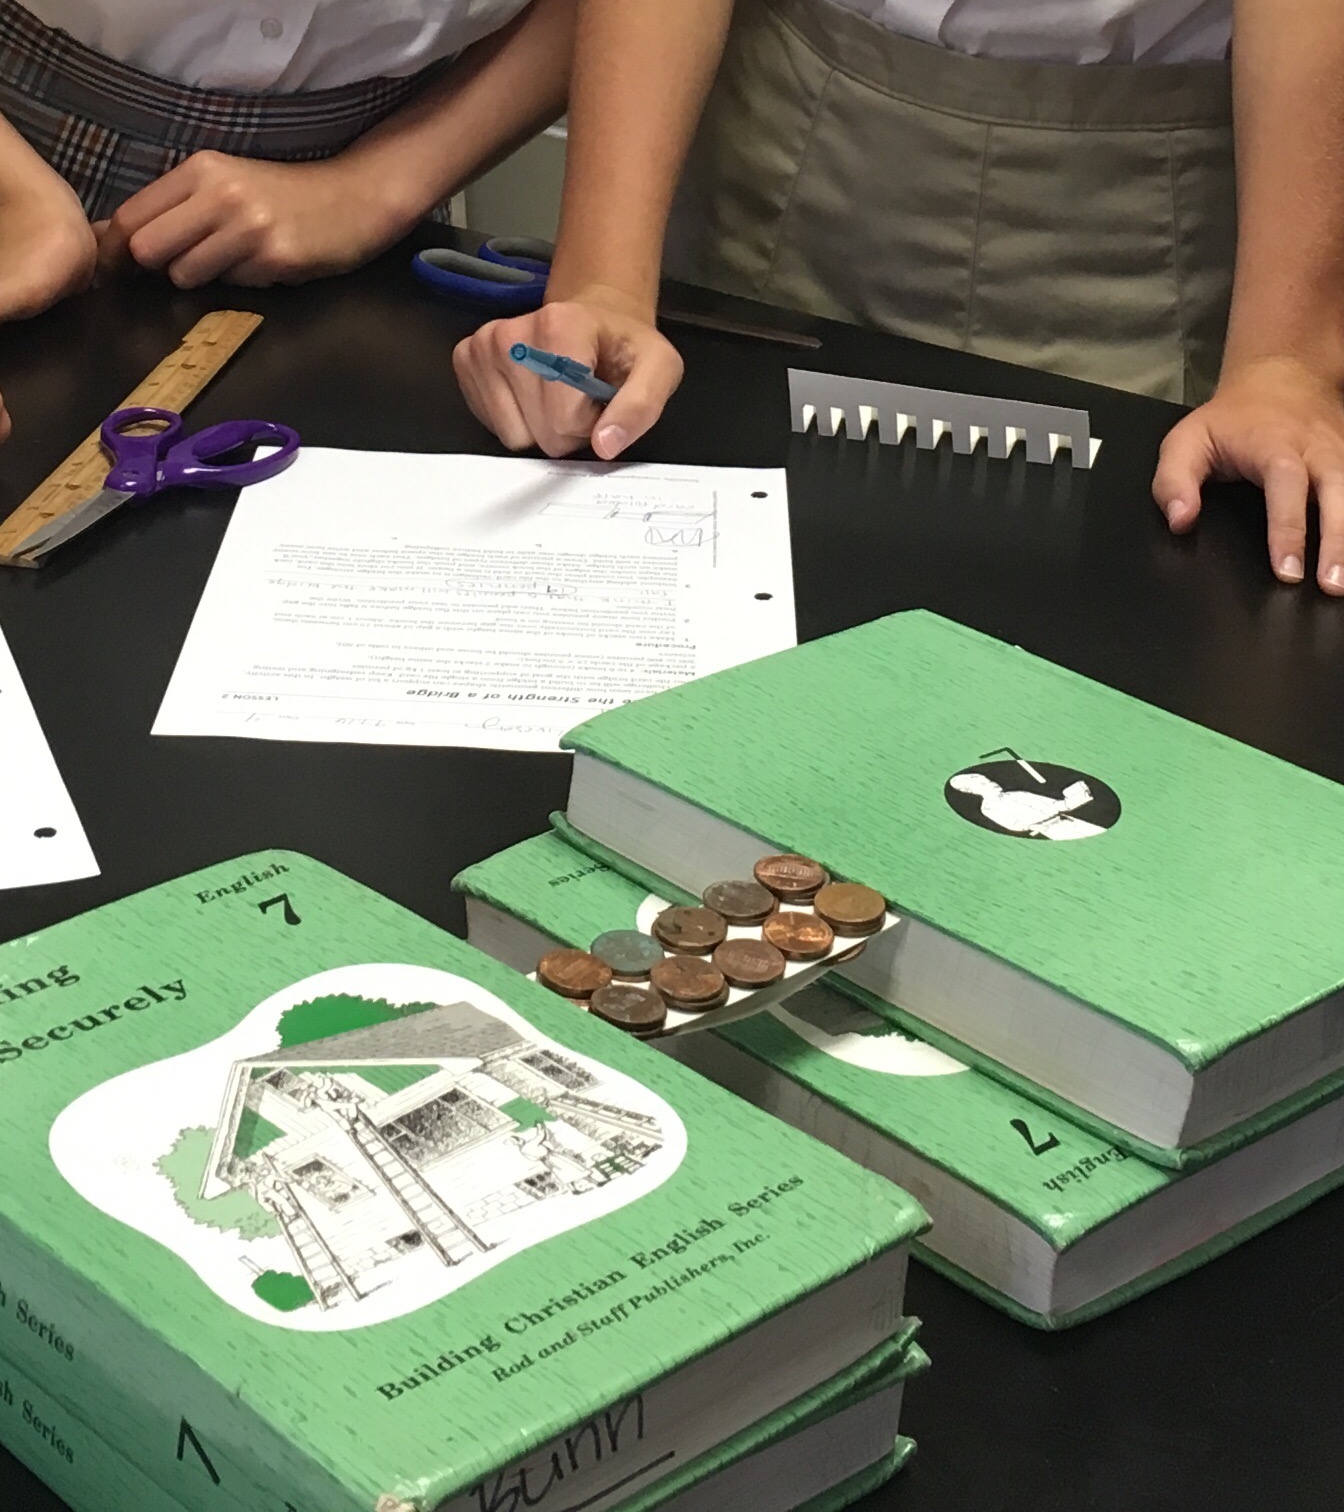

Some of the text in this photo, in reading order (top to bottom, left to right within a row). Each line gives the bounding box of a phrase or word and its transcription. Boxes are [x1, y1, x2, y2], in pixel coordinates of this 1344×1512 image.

[406, 688, 459, 698] Bridge
[507, 693, 579, 703] Strength
[194, 860, 290, 905] English
[547, 862, 611, 887] Series
[258, 893, 303, 927] 7
[1009, 1118, 1061, 1156] 7
[1042, 1146, 1128, 1193] English
[376, 1173, 805, 1403] Building Christian English Series
[492, 1232, 772, 1384] Rod and Staff Publishers, Inc.
[16, 1299, 76, 1363] Series
[22, 1400, 76, 1464] Series
